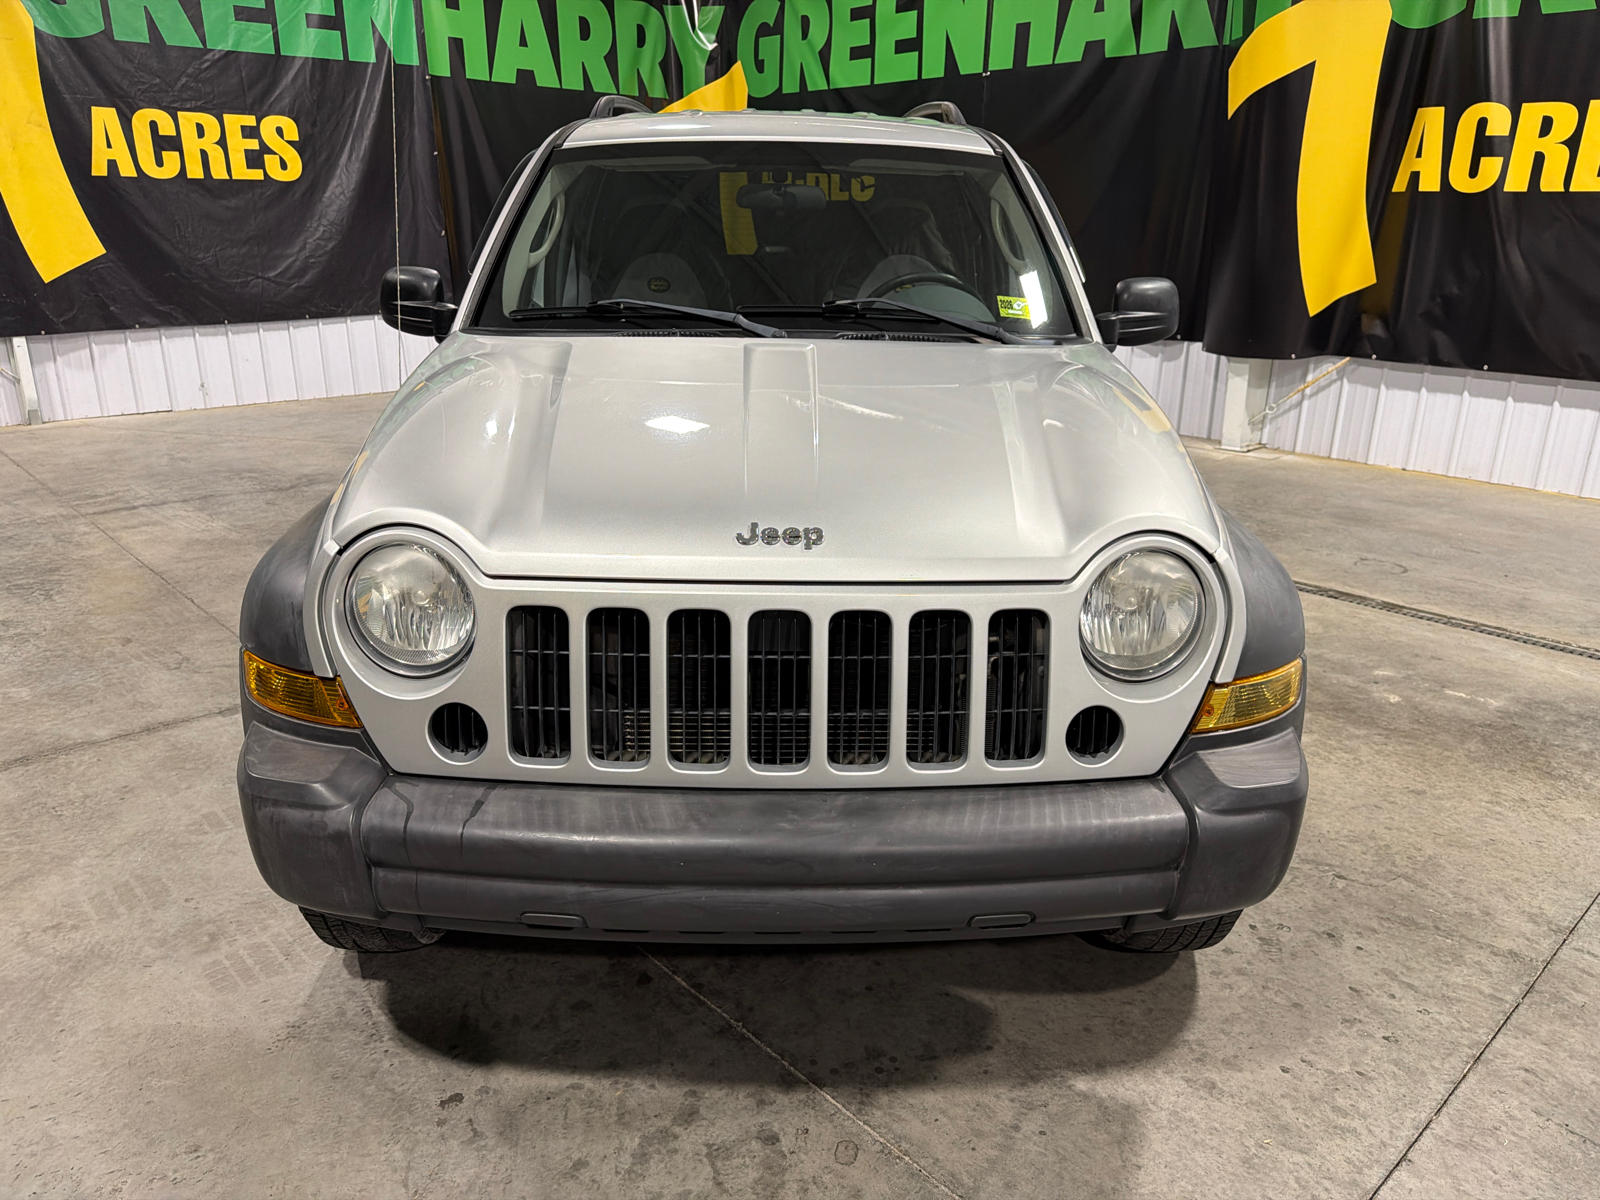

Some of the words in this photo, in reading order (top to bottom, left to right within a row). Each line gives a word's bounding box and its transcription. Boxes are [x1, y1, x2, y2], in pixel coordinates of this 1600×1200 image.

[423, 0, 724, 99] HARRY
[737, 0, 984, 98] GREEN
[91, 106, 303, 182] ACRES
[1228, 0, 1392, 317] 7
[735, 522, 825, 550] Jeep
